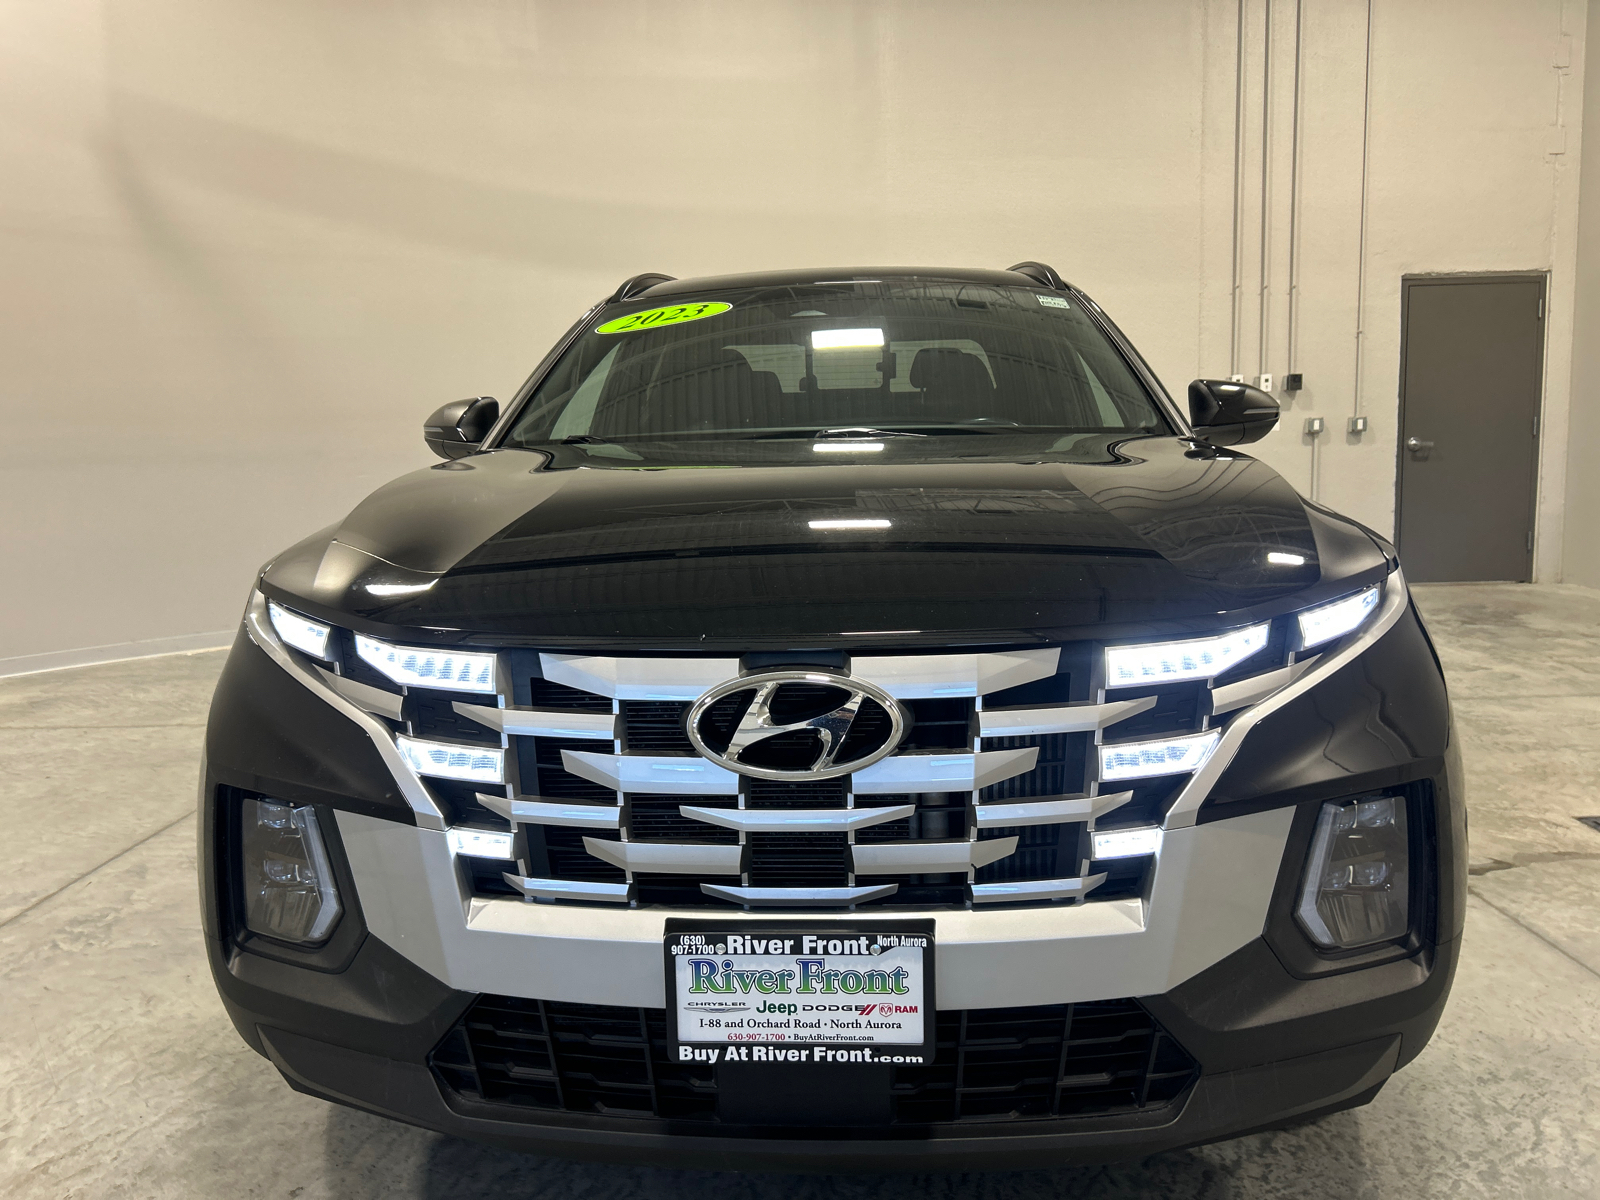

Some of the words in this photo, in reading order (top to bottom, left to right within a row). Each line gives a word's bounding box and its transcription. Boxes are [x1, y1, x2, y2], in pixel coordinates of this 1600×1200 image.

[616, 304, 709, 330] 2023
[679, 935, 705, 945] (630)
[727, 936, 794, 954] River
[803, 936, 869, 954] Front
[877, 935, 899, 947] North
[901, 935, 927, 948] Aurora
[671, 945, 714, 954] 907-1700
[688, 958, 794, 994] River
[796, 958, 909, 994] Front
[756, 1000, 798, 1015] Jeep
[895, 1005, 918, 1013] RAM
[699, 1019, 722, 1028] I-88
[724, 1019, 744, 1028] and
[747, 1018, 791, 1029] Orchard
[793, 1018, 822, 1029] Road
[830, 1019, 863, 1029] North
[864, 1019, 902, 1029] Aurora
[793, 1034, 874, 1042] BuyAtRiverFront.com
[679, 1046, 719, 1063] Buy
[724, 1046, 749, 1061] At
[752, 1046, 808, 1062] River
[814, 1047, 924, 1063] Front.com
